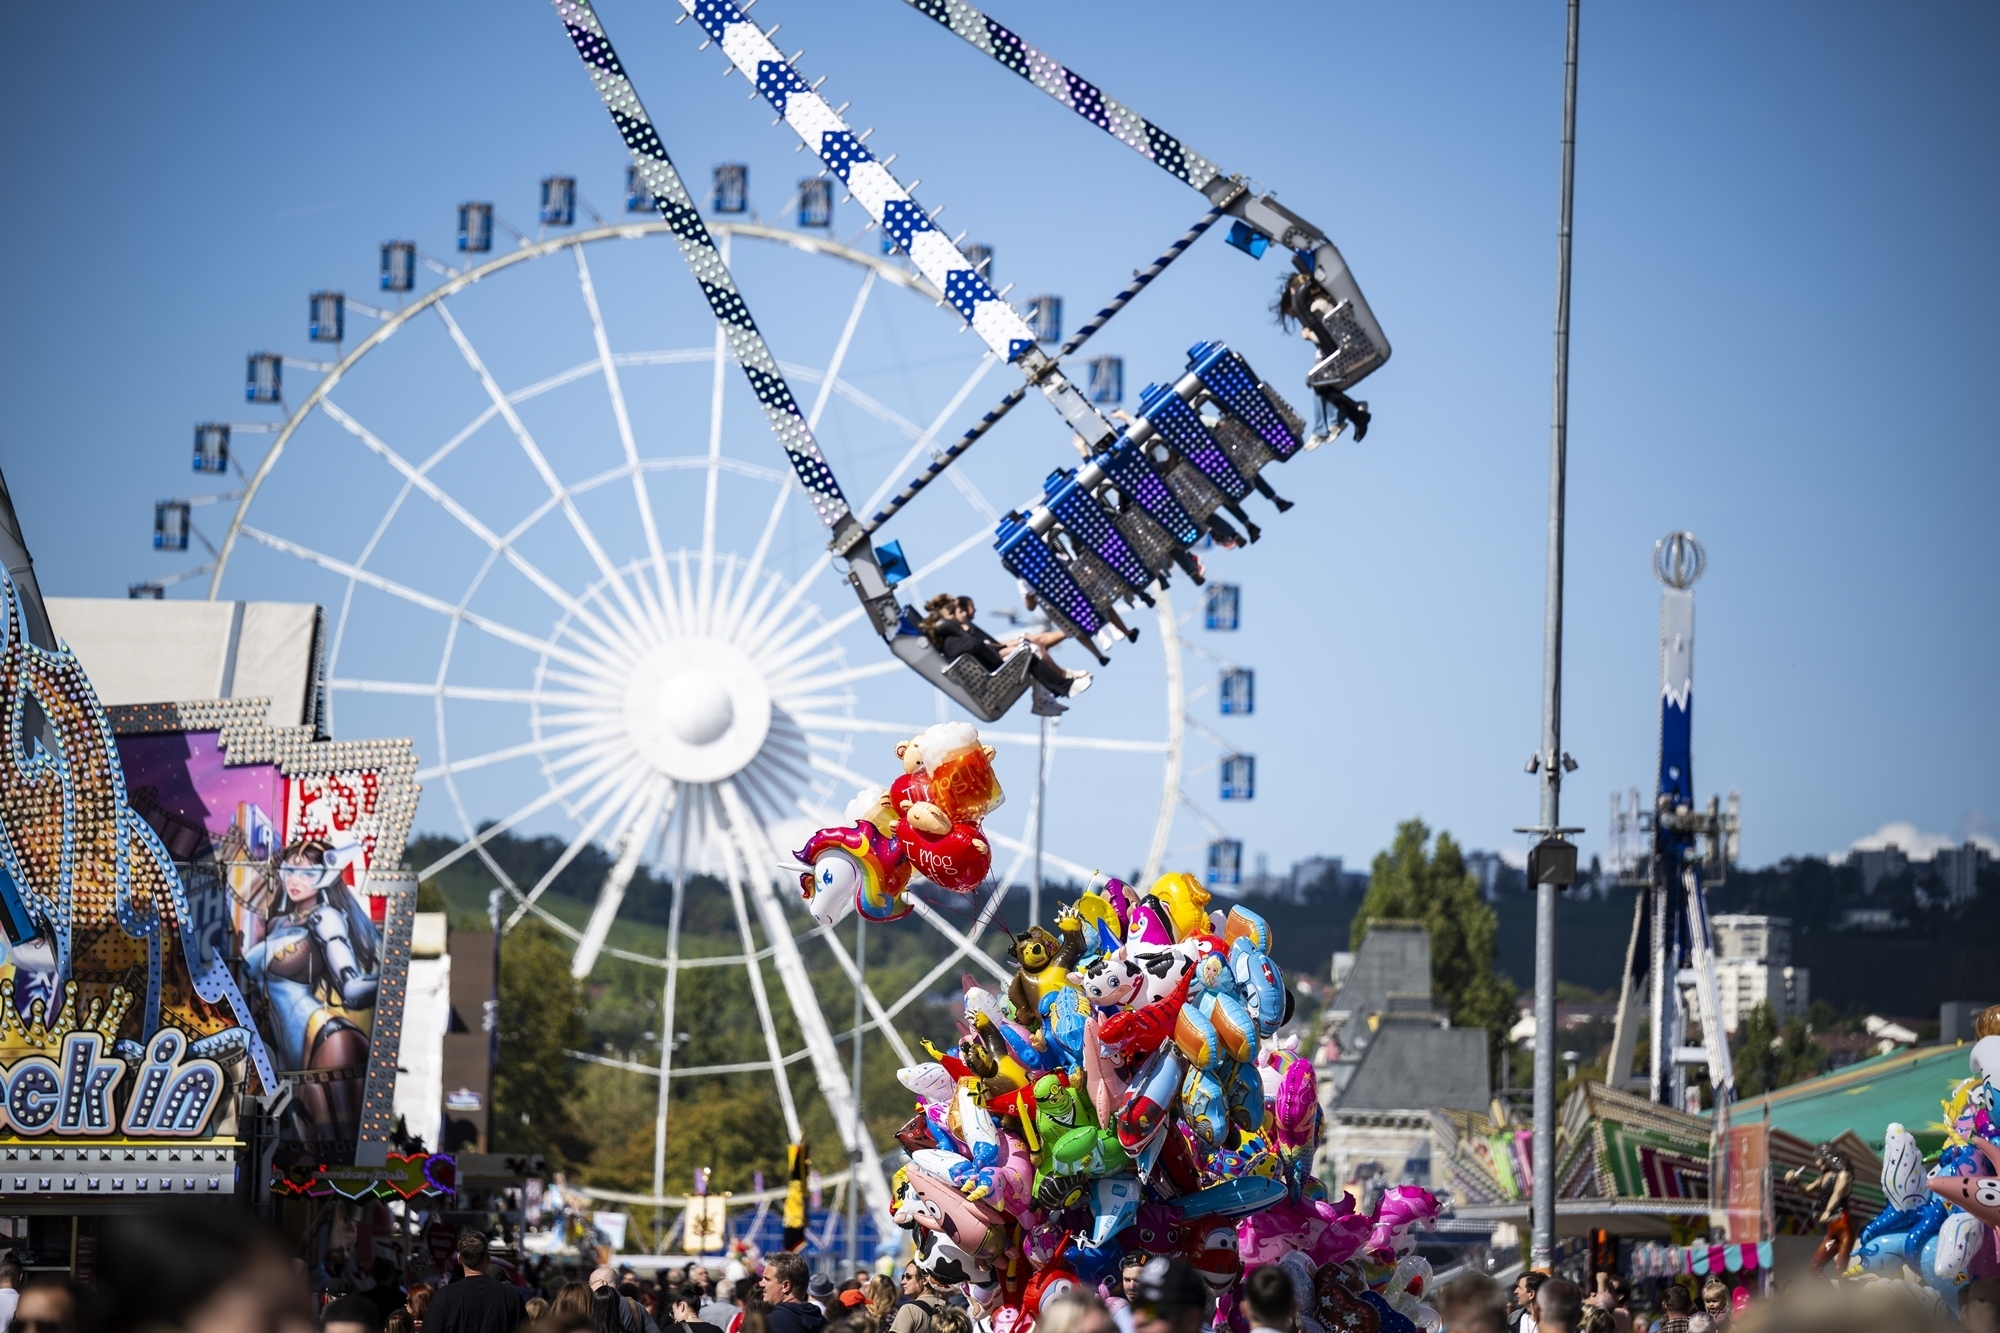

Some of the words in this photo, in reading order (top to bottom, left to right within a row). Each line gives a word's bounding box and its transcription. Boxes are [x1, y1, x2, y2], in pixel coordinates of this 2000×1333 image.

[902, 840, 915, 861] I
[919, 848, 958, 875] mog
[0, 1036, 121, 1131] ck
[127, 1031, 219, 1132] in
[1104, 1203, 1120, 1229] POLICE
